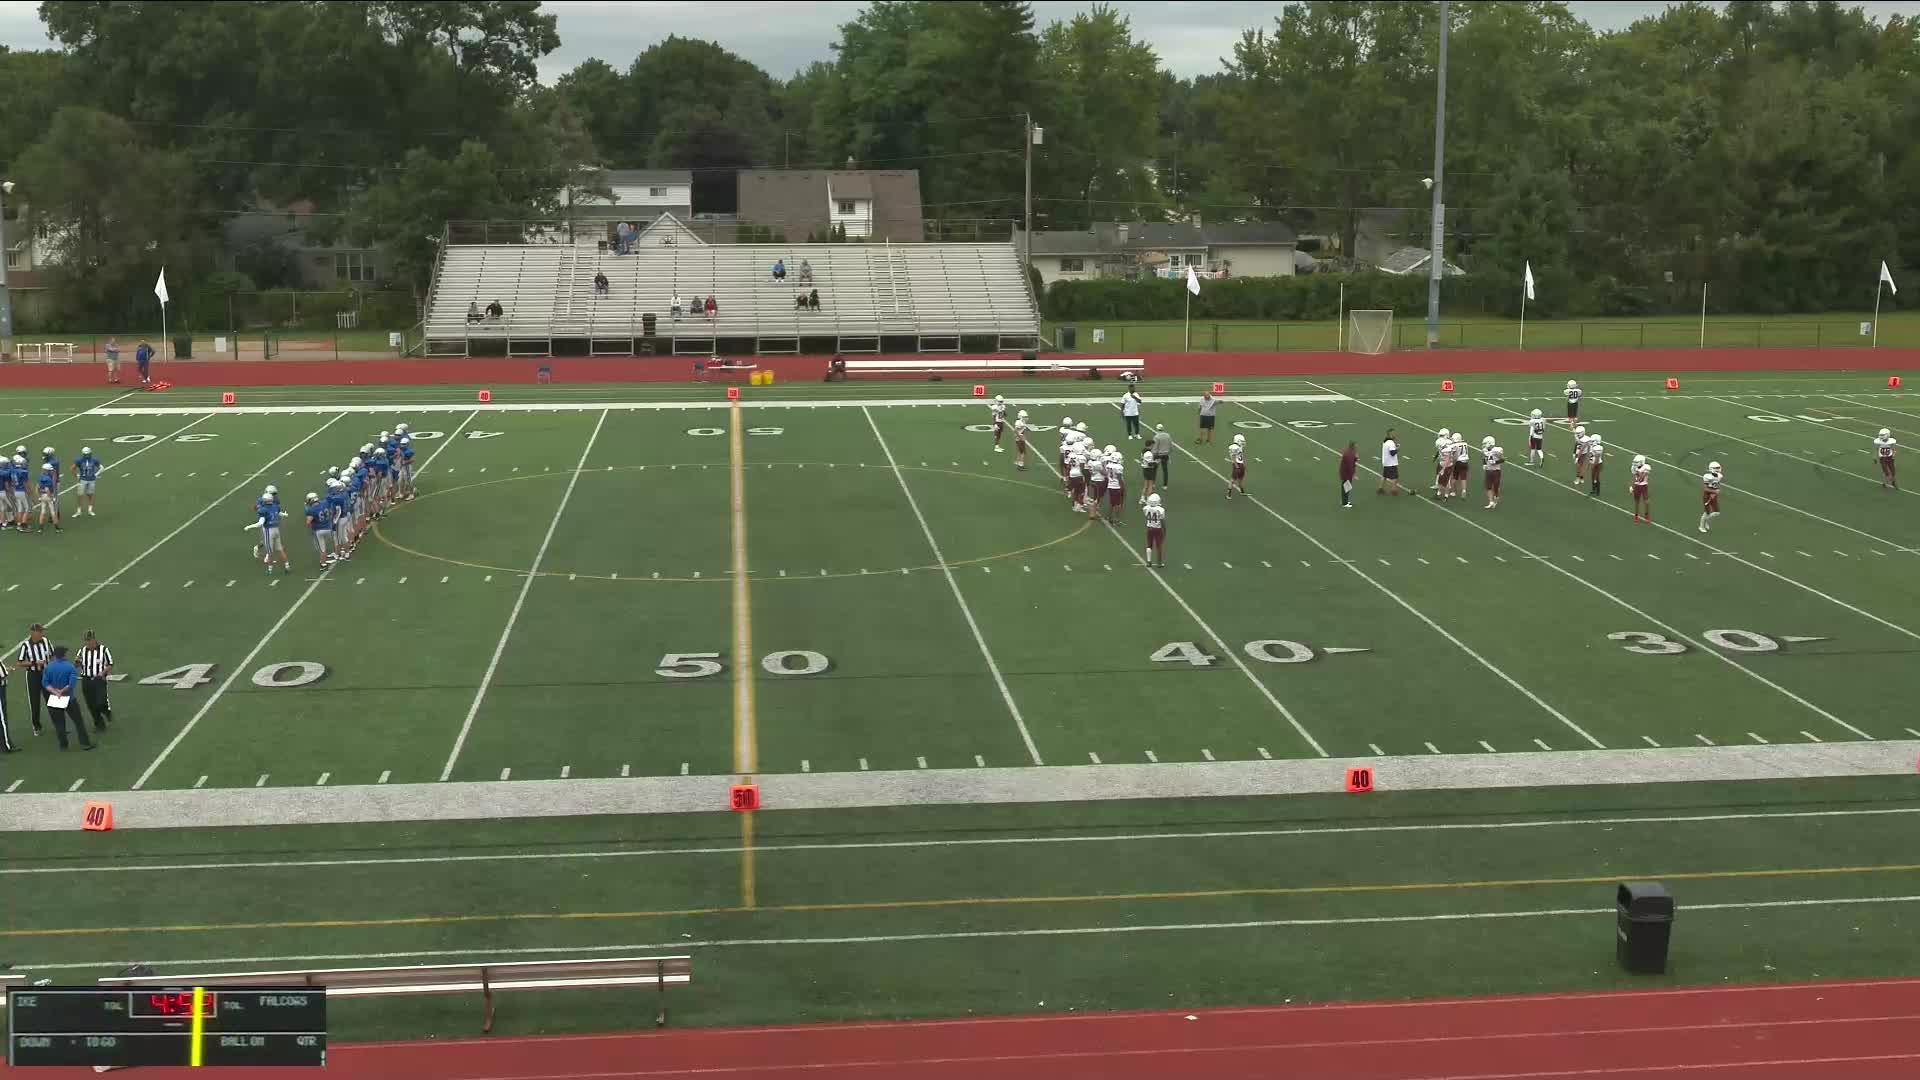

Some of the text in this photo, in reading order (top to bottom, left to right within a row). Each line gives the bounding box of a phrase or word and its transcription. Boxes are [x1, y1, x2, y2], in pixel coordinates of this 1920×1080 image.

[1213, 383, 1223, 393] 30
[1568, 390, 1578, 400] 20
[687, 427, 784, 436] 50
[1145, 511, 1159, 524] 44
[1607, 629, 1779, 654] 30
[1150, 640, 1315, 666] 40
[655, 650, 829, 678] 50
[137, 662, 325, 689] 40
[1351, 770, 1369, 789] 40
[732, 789, 754, 808] 50
[86, 806, 105, 826] 40
